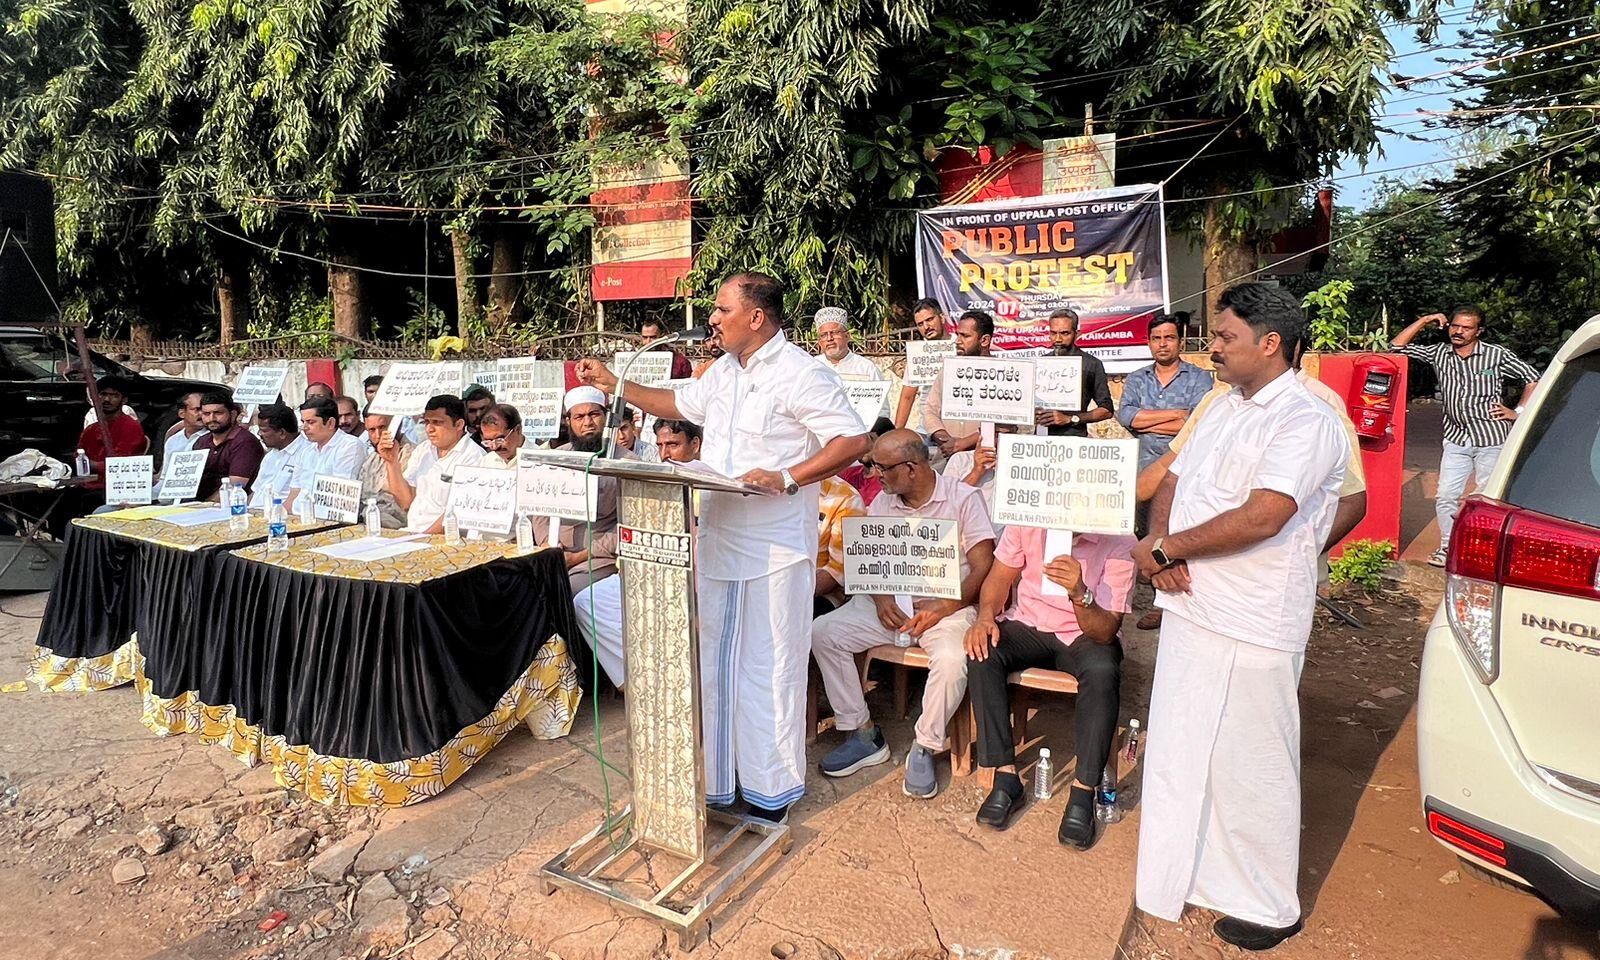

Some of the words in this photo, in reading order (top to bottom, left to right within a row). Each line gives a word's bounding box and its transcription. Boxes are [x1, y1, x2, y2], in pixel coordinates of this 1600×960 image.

[943, 217, 954, 226] IN
[956, 214, 992, 225] FRONT
[994, 212, 1008, 222] OF
[1011, 208, 1054, 220] UPPALA
[1057, 206, 1088, 216] POST
[1092, 201, 1135, 213] OFFICE
[941, 220, 1075, 259] PUBLIC
[959, 252, 1135, 292] PROTEST
[600, 276, 623, 287] e-Post
[968, 300, 995, 310] 2024
[1020, 294, 1064, 302] THURSDAY
[997, 302, 1018, 316] 07
[1082, 331, 1134, 341] KAIKAMBA
[1012, 441, 1073, 463] ഈസ്റ്റും
[1010, 464, 1071, 486] വെസ്റ്റും
[1007, 488, 1040, 508] ഉപ്പള
[998, 512, 1023, 522] UPPALA
[1025, 514, 1034, 522] NH
[861, 524, 885, 538] ഉപ്പള
[924, 586, 956, 595] COMMITTEE
[1540, 637, 1600, 656] CRYS
